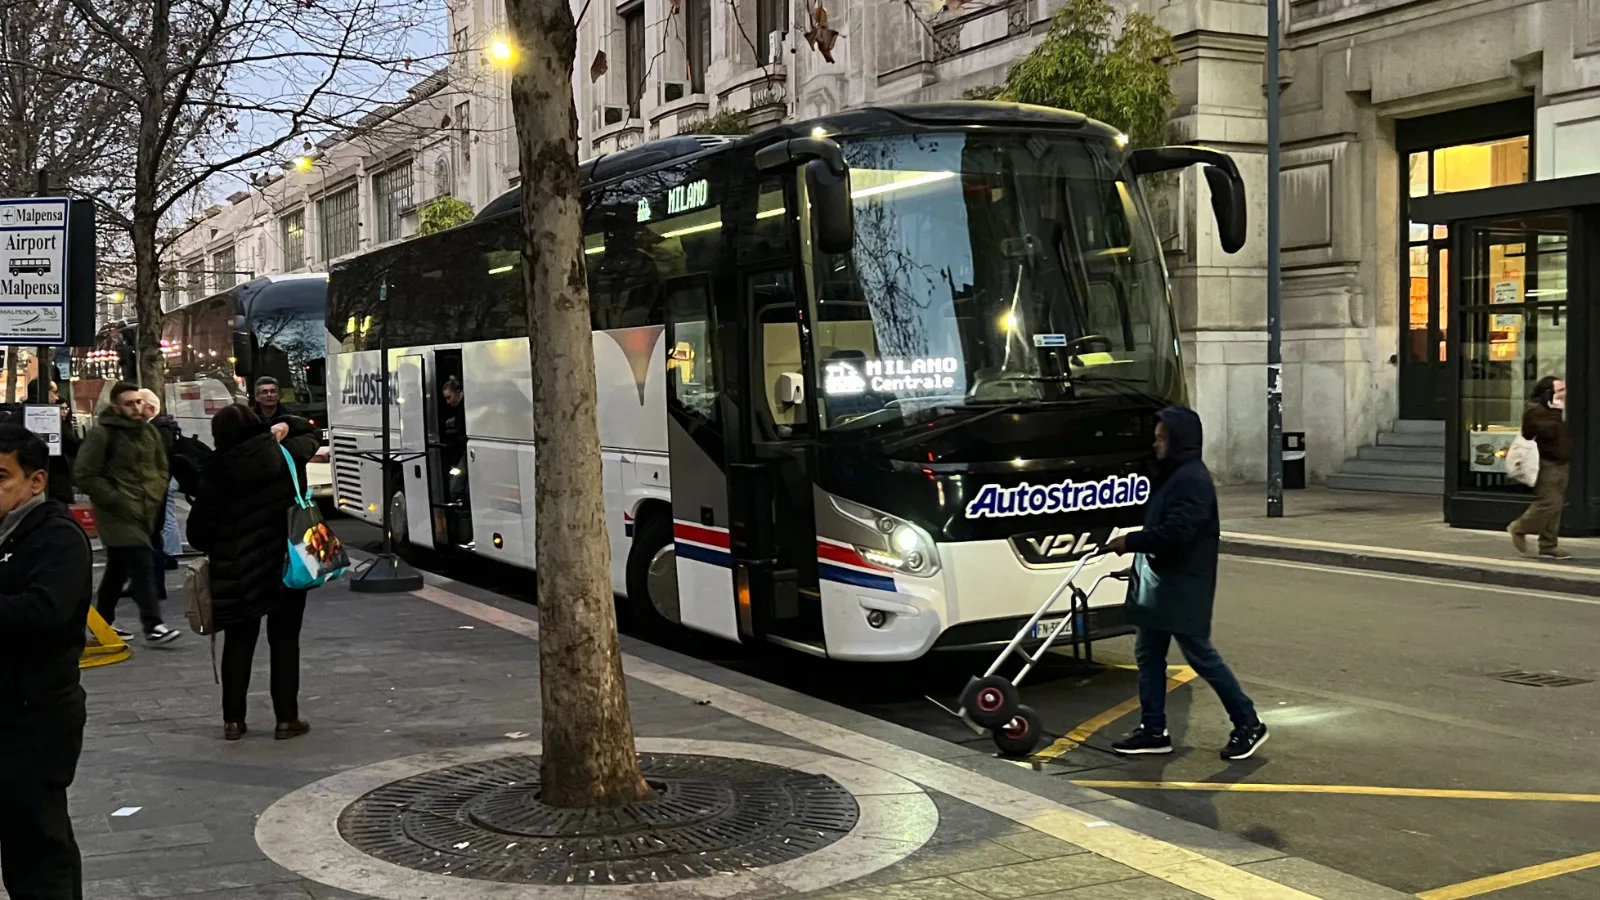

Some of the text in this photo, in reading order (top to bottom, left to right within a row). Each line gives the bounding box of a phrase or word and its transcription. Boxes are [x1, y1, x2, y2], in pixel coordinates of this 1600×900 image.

[667, 179, 708, 215] MILANO
[16, 207, 63, 225] Malpensa
[6, 233, 56, 255] Airport
[0, 279, 60, 299] Malpensa
[865, 357, 958, 375] MILANO
[871, 374, 955, 391] Centrale
[967, 474, 1150, 517] Autostradale
[1026, 532, 1097, 557] VDL
